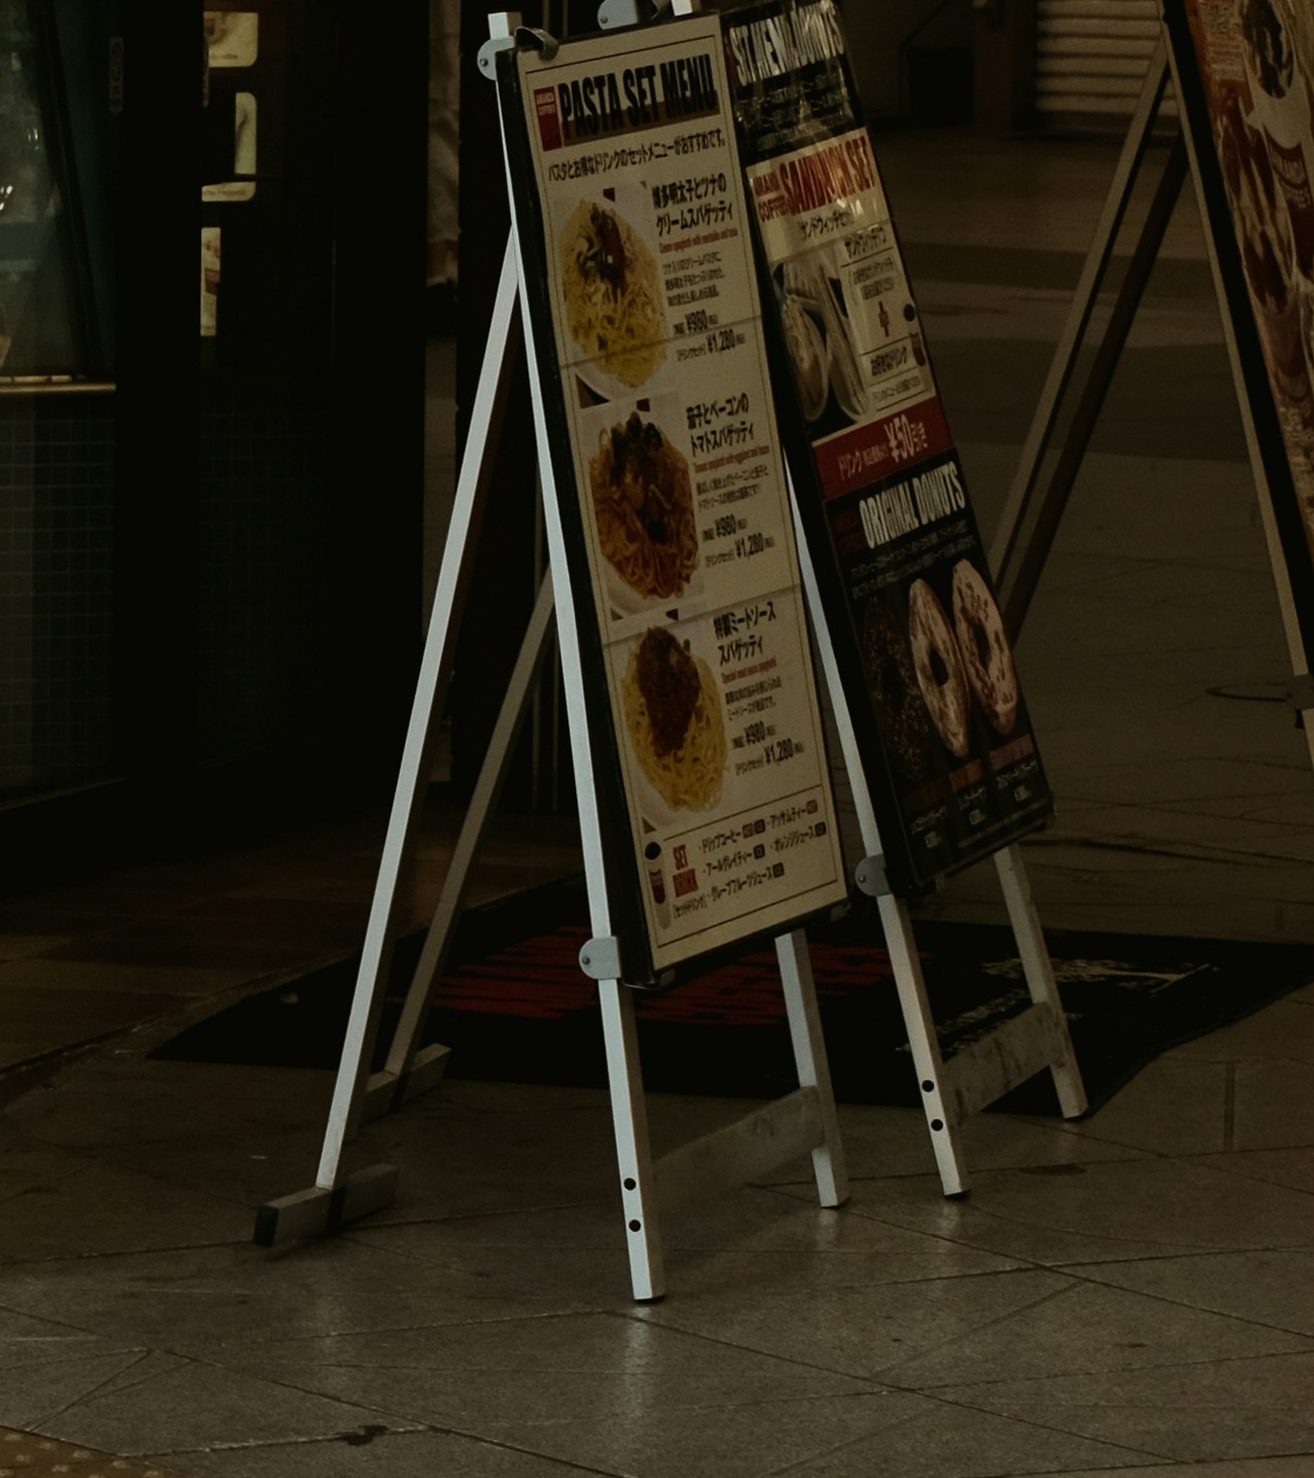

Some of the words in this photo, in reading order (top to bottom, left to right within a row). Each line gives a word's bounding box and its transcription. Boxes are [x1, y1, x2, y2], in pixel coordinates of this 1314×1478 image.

[556, 71, 625, 141] PASTA
[620, 63, 662, 127] SET
[658, 52, 719, 120] MENU
[856, 478, 920, 554] ORIGINAL
[910, 456, 967, 529] DONUTS
[717, 632, 764, 668] スパゲッティ
[763, 737, 795, 767] ¥1,280
